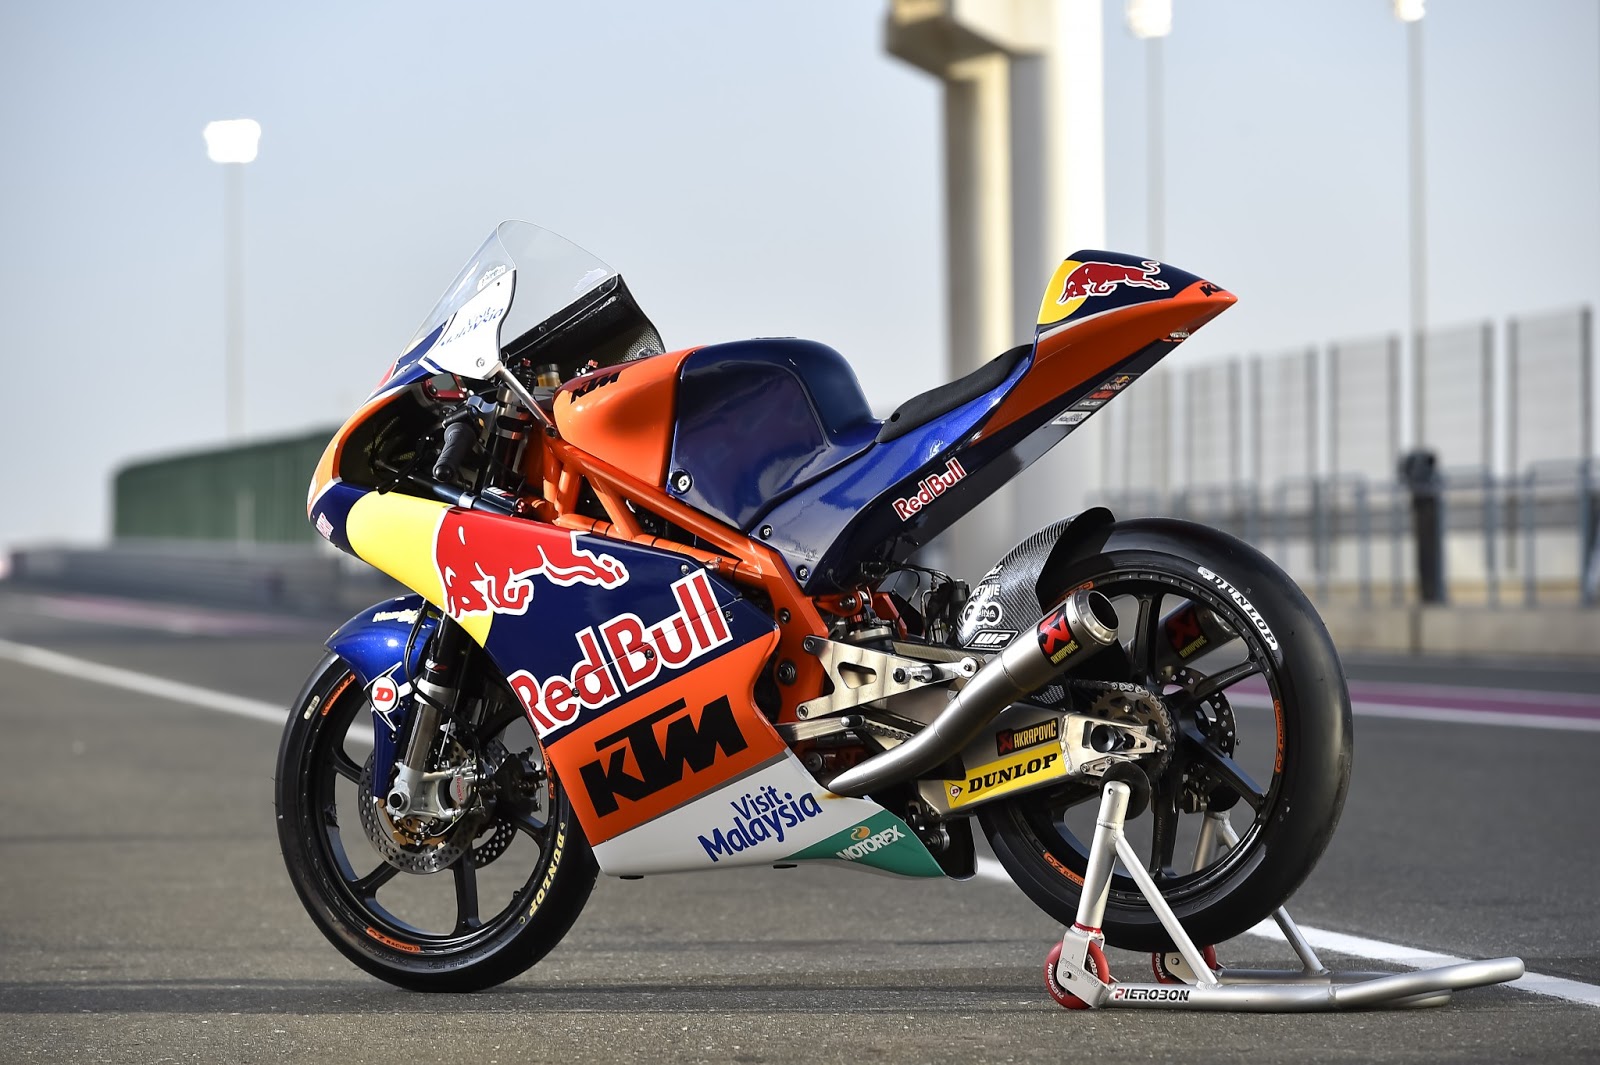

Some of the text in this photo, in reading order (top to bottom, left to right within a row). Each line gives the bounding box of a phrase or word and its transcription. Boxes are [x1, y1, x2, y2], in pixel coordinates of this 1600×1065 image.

[570, 371, 622, 405] KTM
[1213, 573, 1277, 645] DUNLOP
[579, 694, 749, 818] KTM
[968, 753, 1058, 794] DUNLOP
[730, 785, 784, 821] Visit
[697, 792, 823, 863] Malaysia
[836, 825, 906, 861] MOTOREX
[528, 831, 565, 917] DUNLOP
[1114, 988, 1190, 1001] PIEROBON
